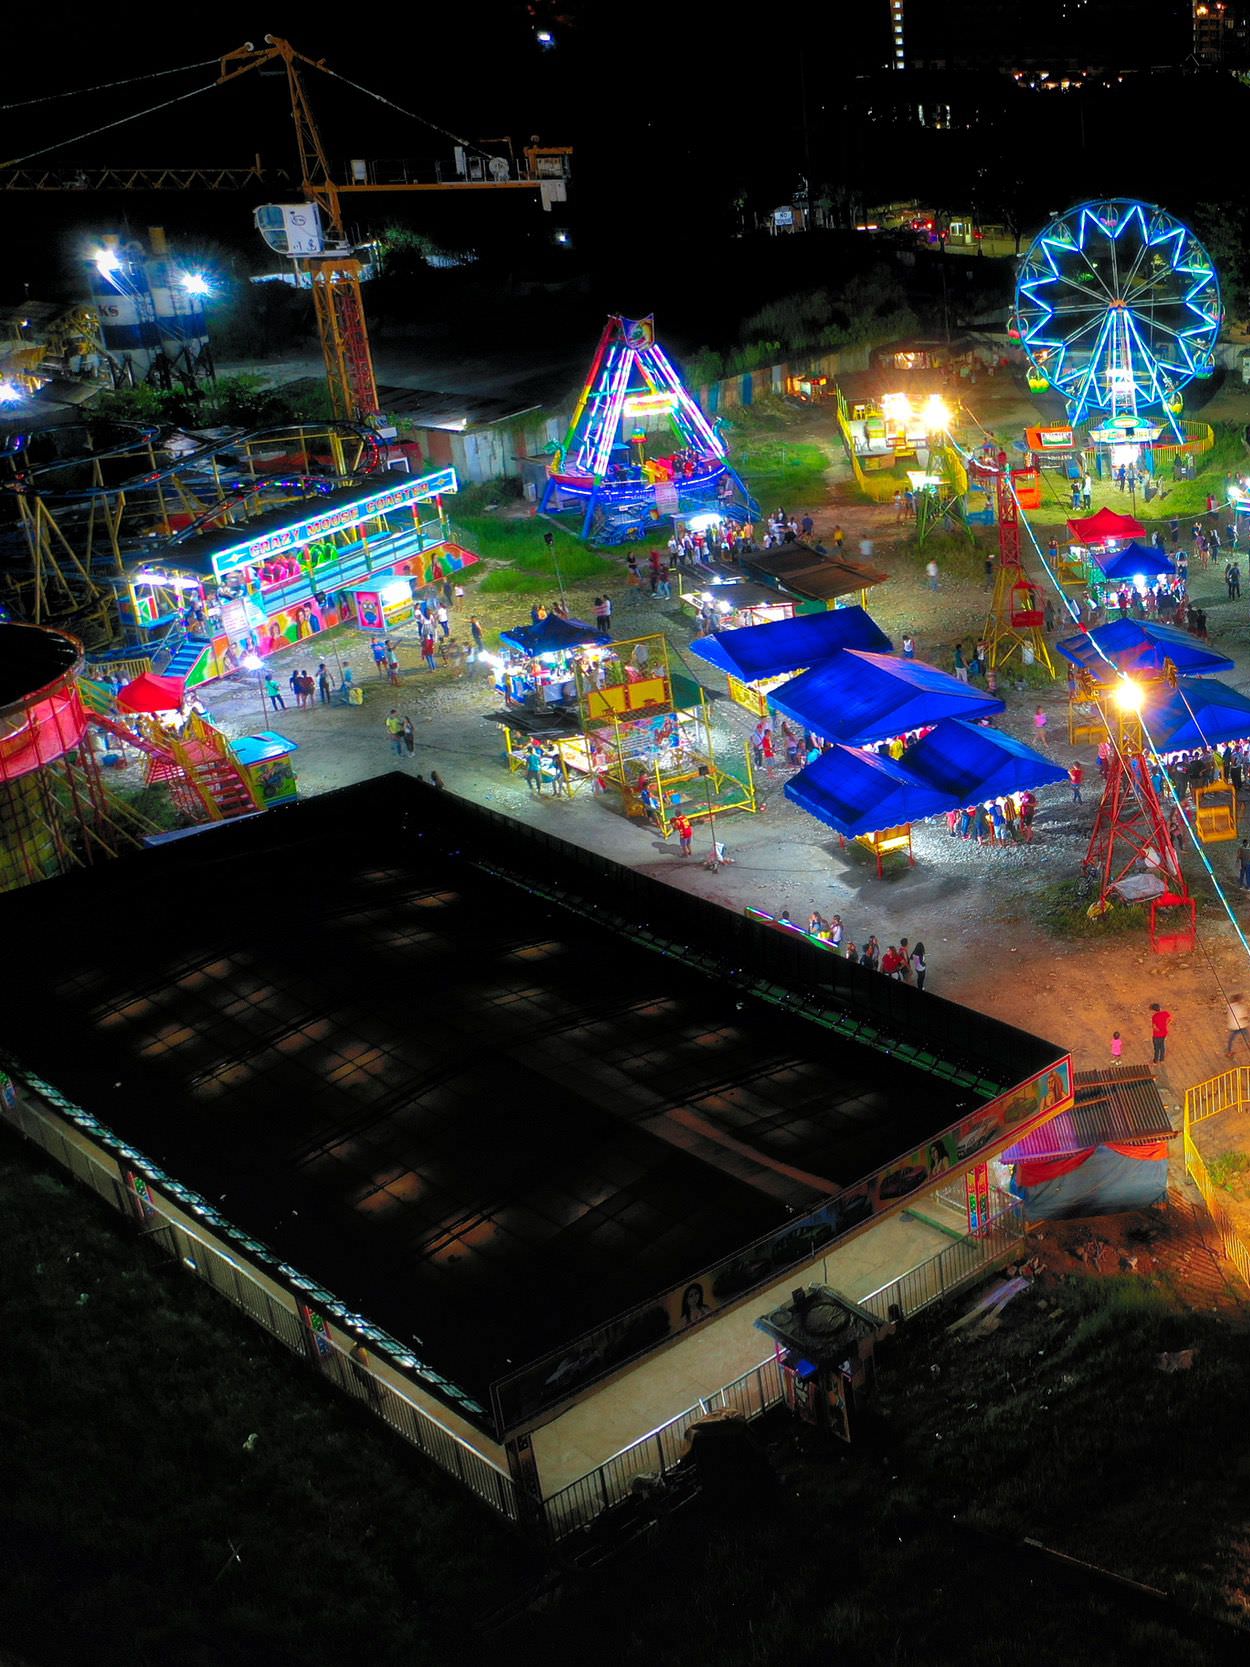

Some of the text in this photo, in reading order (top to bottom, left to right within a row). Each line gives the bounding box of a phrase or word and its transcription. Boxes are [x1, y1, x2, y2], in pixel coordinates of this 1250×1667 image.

[249, 482, 430, 556] CRAZY MOUSE COASTER
